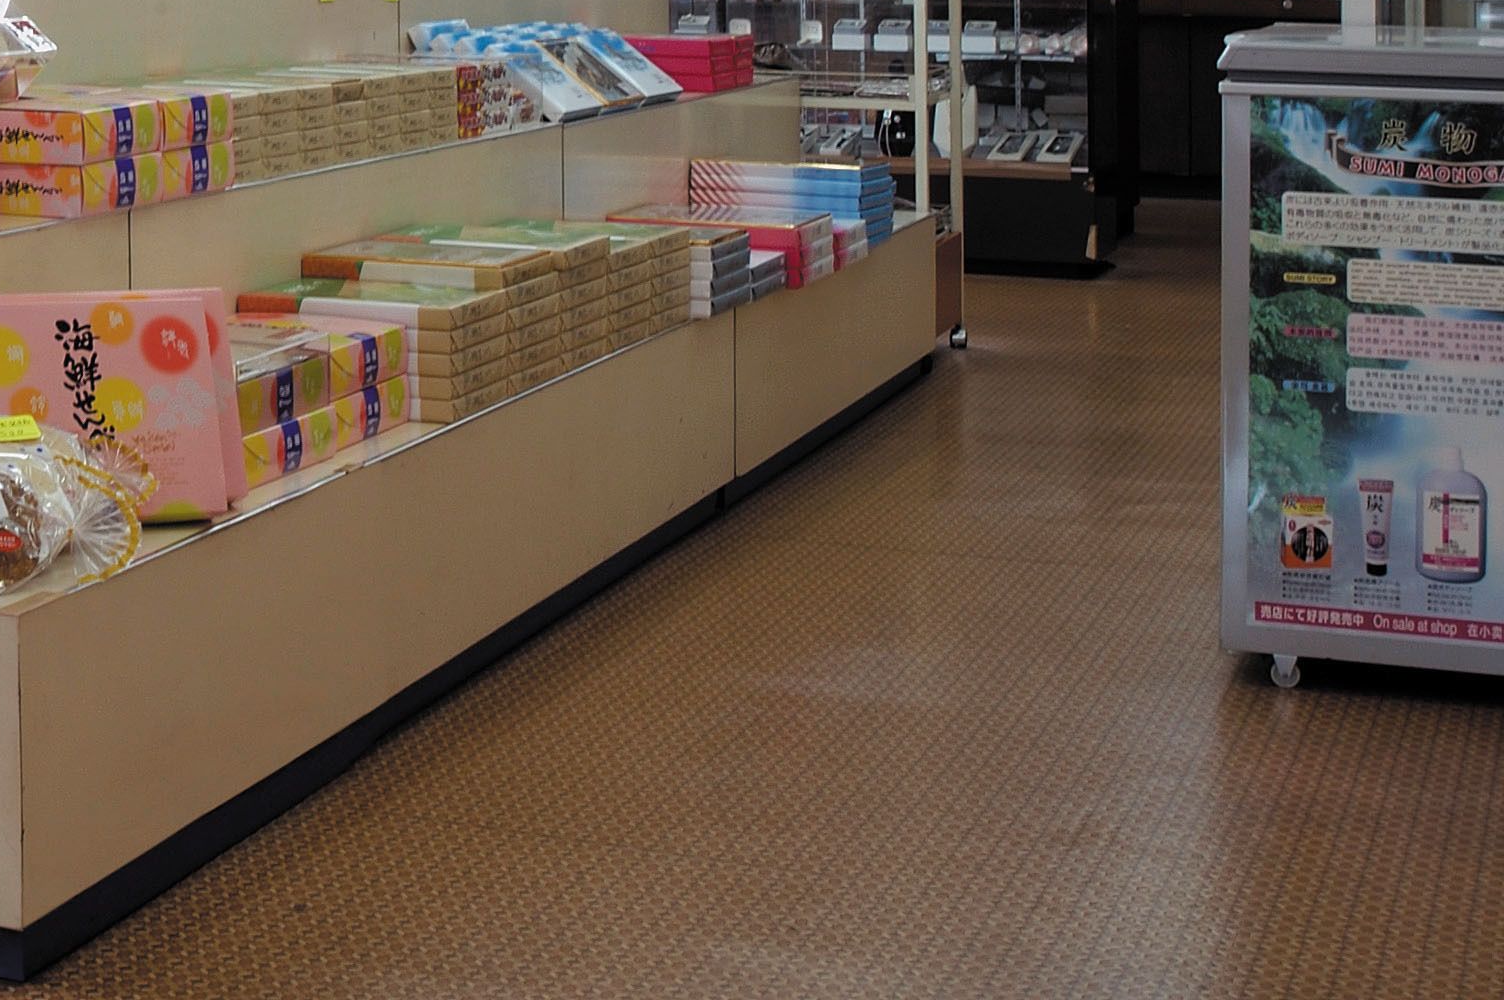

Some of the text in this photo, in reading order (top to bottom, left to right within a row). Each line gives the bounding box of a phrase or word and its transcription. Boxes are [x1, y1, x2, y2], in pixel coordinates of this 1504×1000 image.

[1348, 155, 1405, 178] SUMI
[53, 317, 115, 451] 海鮮せんべ
[1372, 614, 1390, 630] On
[1392, 616, 1415, 632] sale
[1417, 620, 1428, 633] at
[1430, 620, 1458, 636] shop
